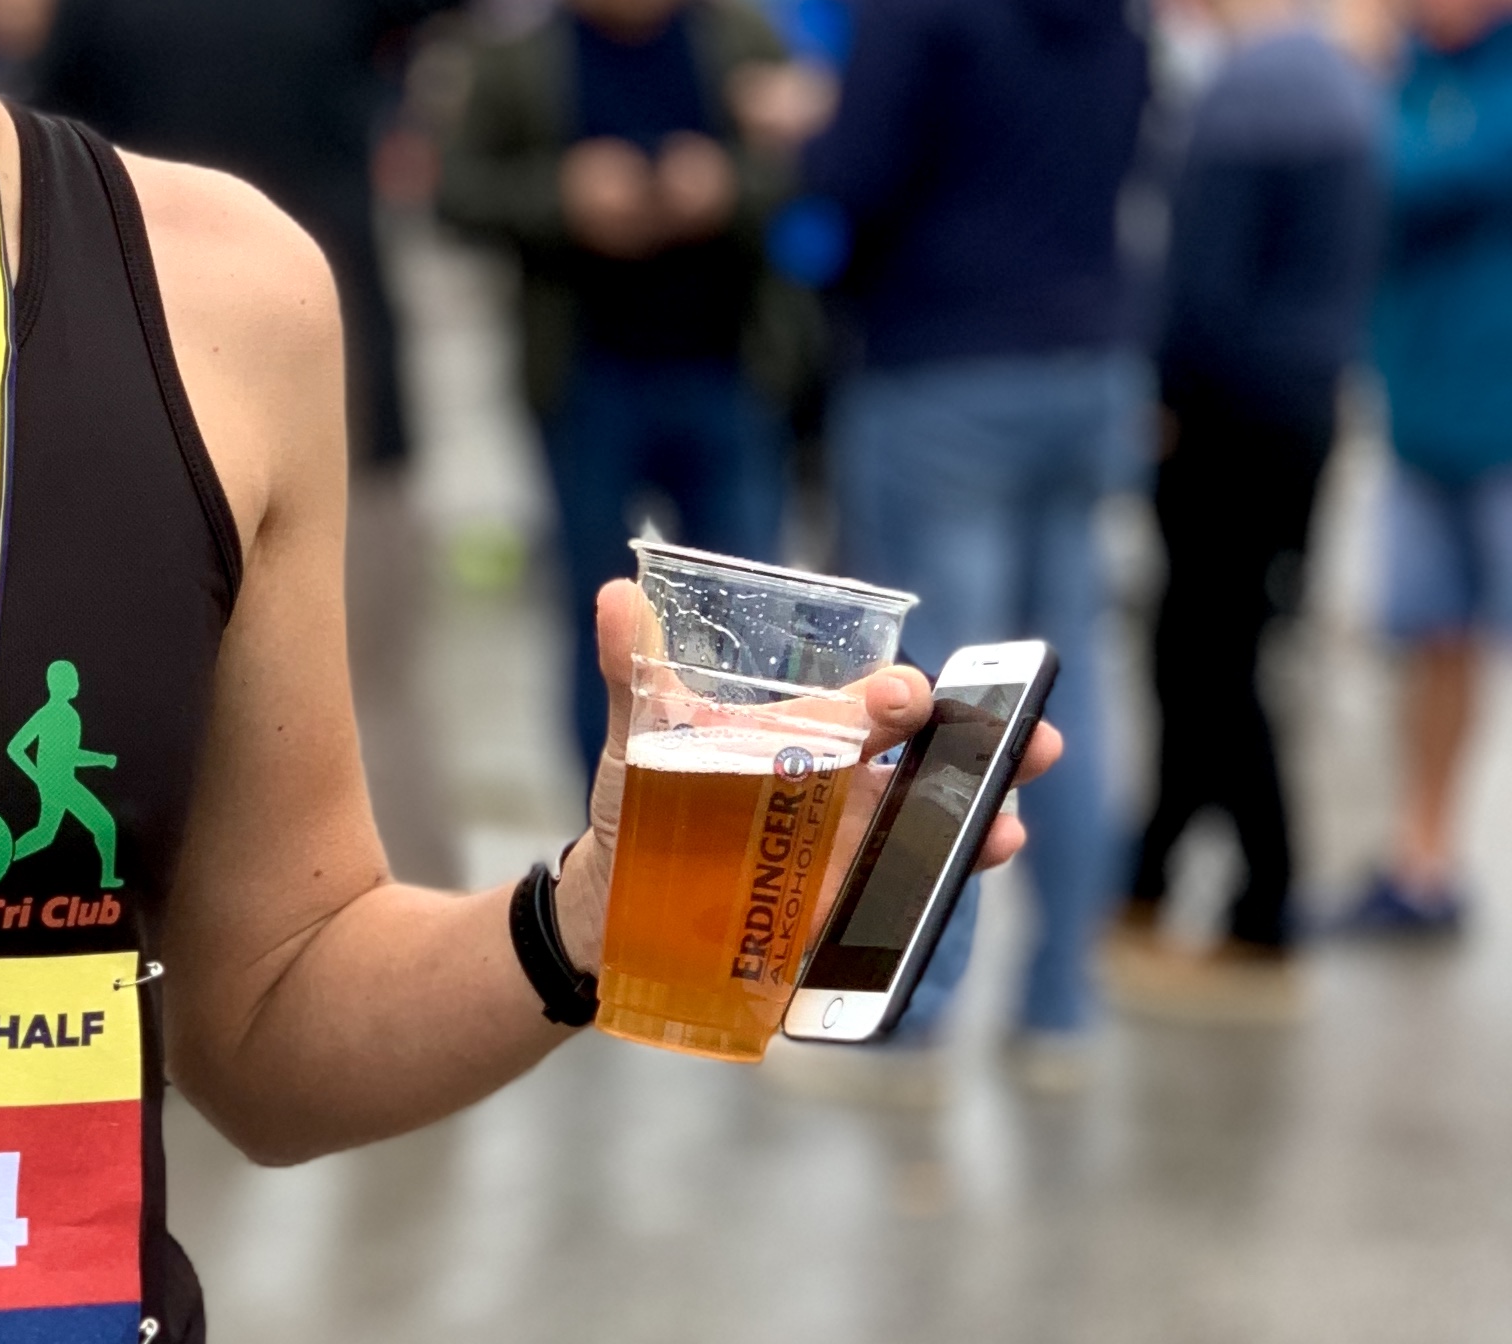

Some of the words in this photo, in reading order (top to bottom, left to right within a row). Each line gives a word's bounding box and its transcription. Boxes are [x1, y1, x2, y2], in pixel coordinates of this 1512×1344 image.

[40, 894, 121, 929] Club
[731, 790, 807, 982] ERDINGER
[770, 752, 837, 986] ALKOHOLFREI
